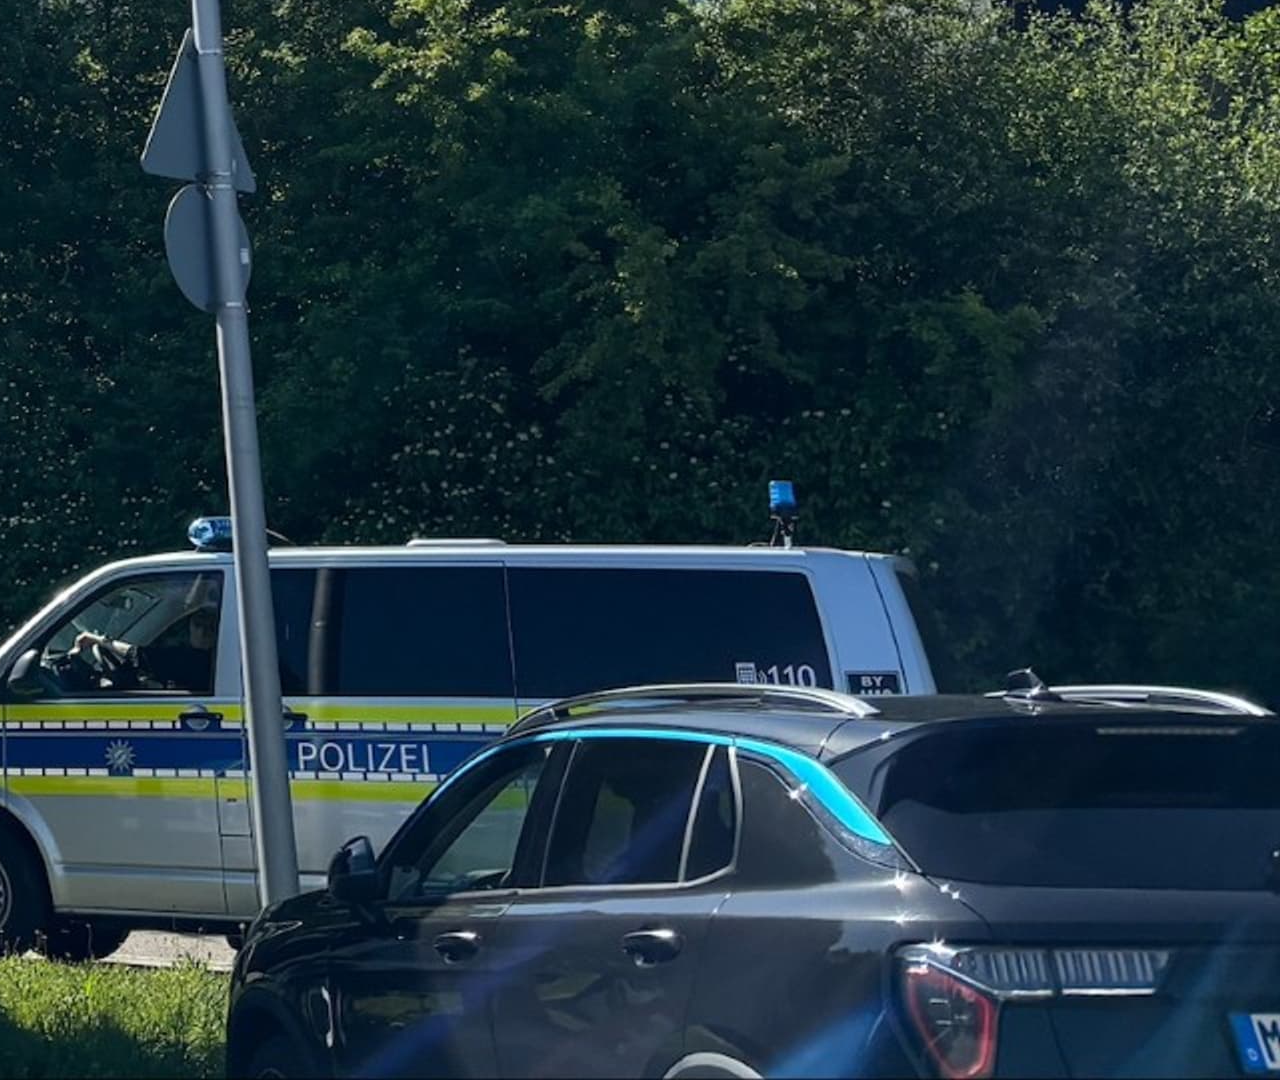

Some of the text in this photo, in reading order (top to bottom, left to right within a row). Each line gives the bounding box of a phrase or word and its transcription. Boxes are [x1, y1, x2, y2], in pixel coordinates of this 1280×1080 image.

[767, 664, 817, 689] 110
[860, 675, 884, 687] BY
[297, 742, 431, 773] POLIZEI
